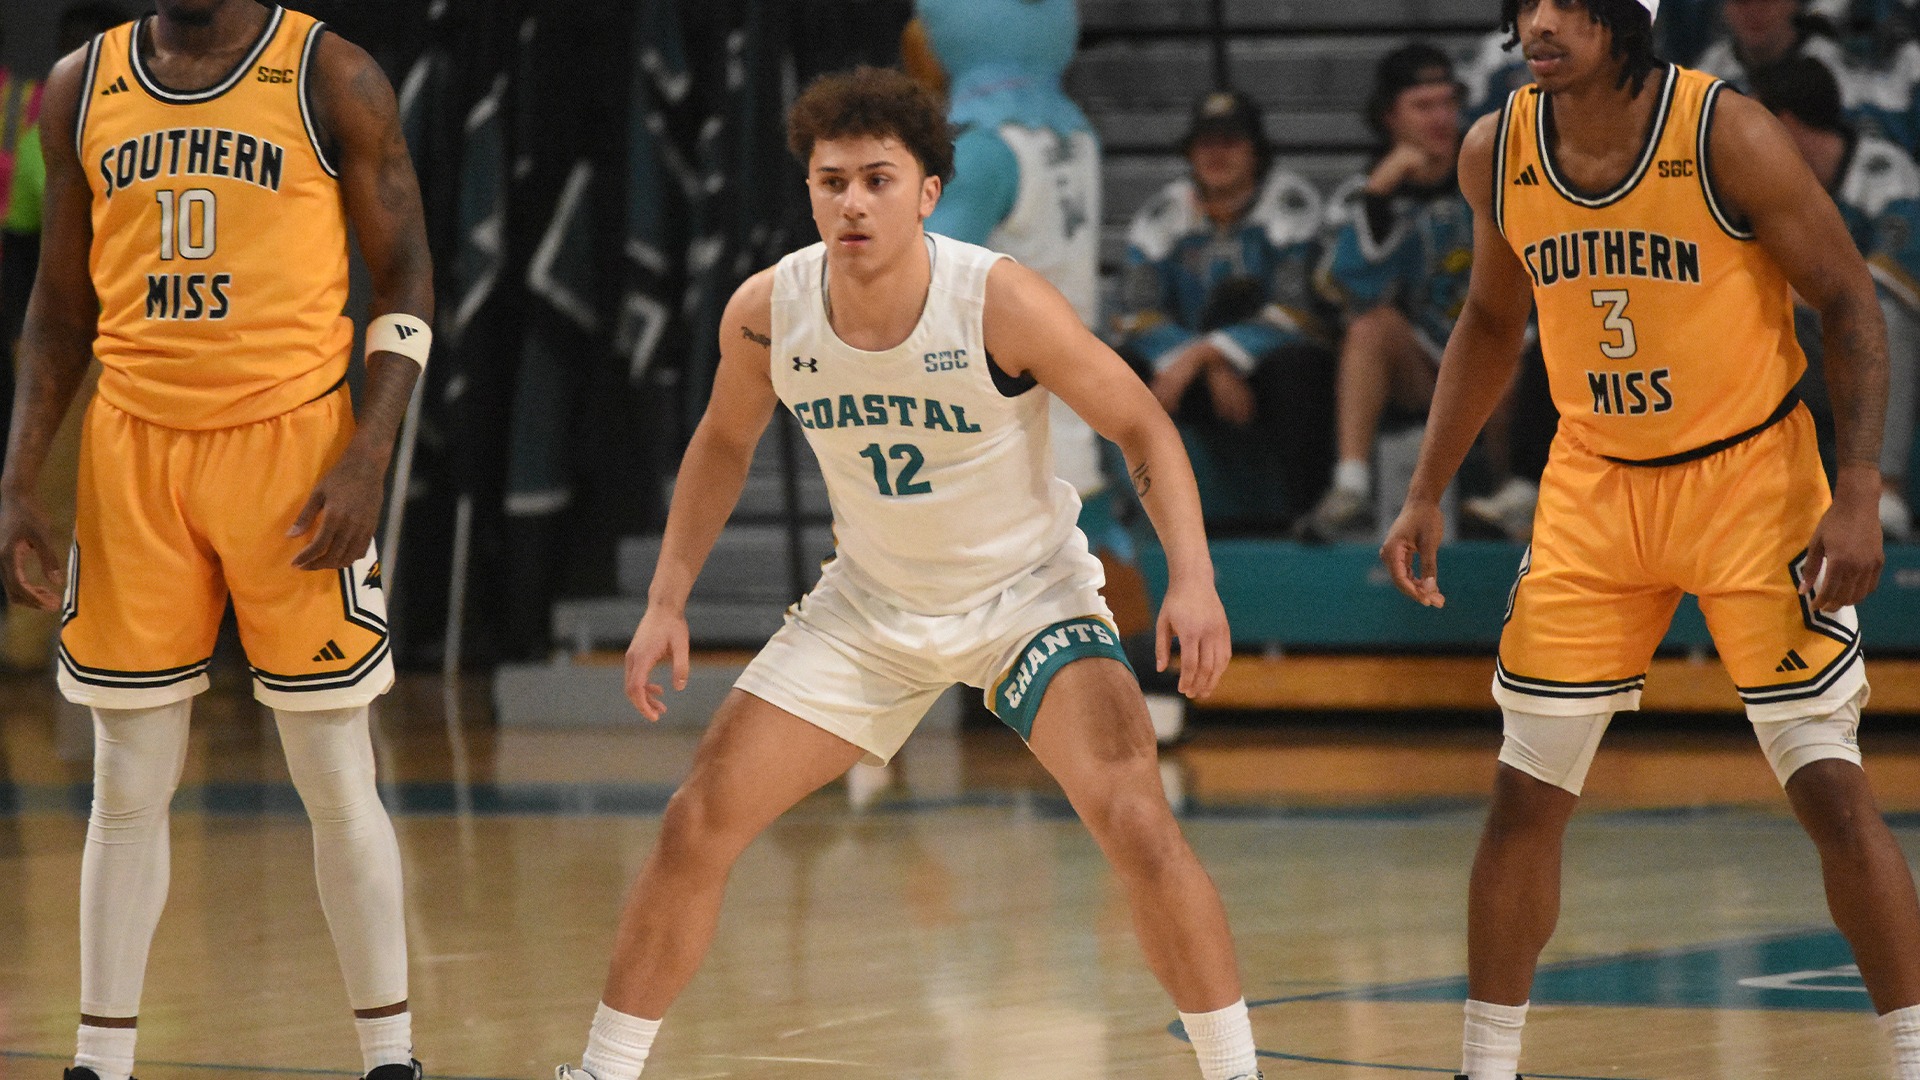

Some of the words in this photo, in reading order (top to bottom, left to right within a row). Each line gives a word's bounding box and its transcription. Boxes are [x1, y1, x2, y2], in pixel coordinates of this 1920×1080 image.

[257, 66, 294, 84] SBC
[100, 127, 284, 200] SOUTHERN
[1658, 160, 1693, 179] SBC
[156, 188, 216, 260] 10
[1523, 228, 1701, 288] SOUTHERN
[145, 273, 232, 321] MISS
[1591, 289, 1637, 359] 3
[923, 349, 969, 373] SBC
[794, 394, 982, 433] COASTAL
[1586, 368, 1673, 416] MISS
[859, 443, 932, 496] 12
[1004, 623, 1114, 709] CHANTS
